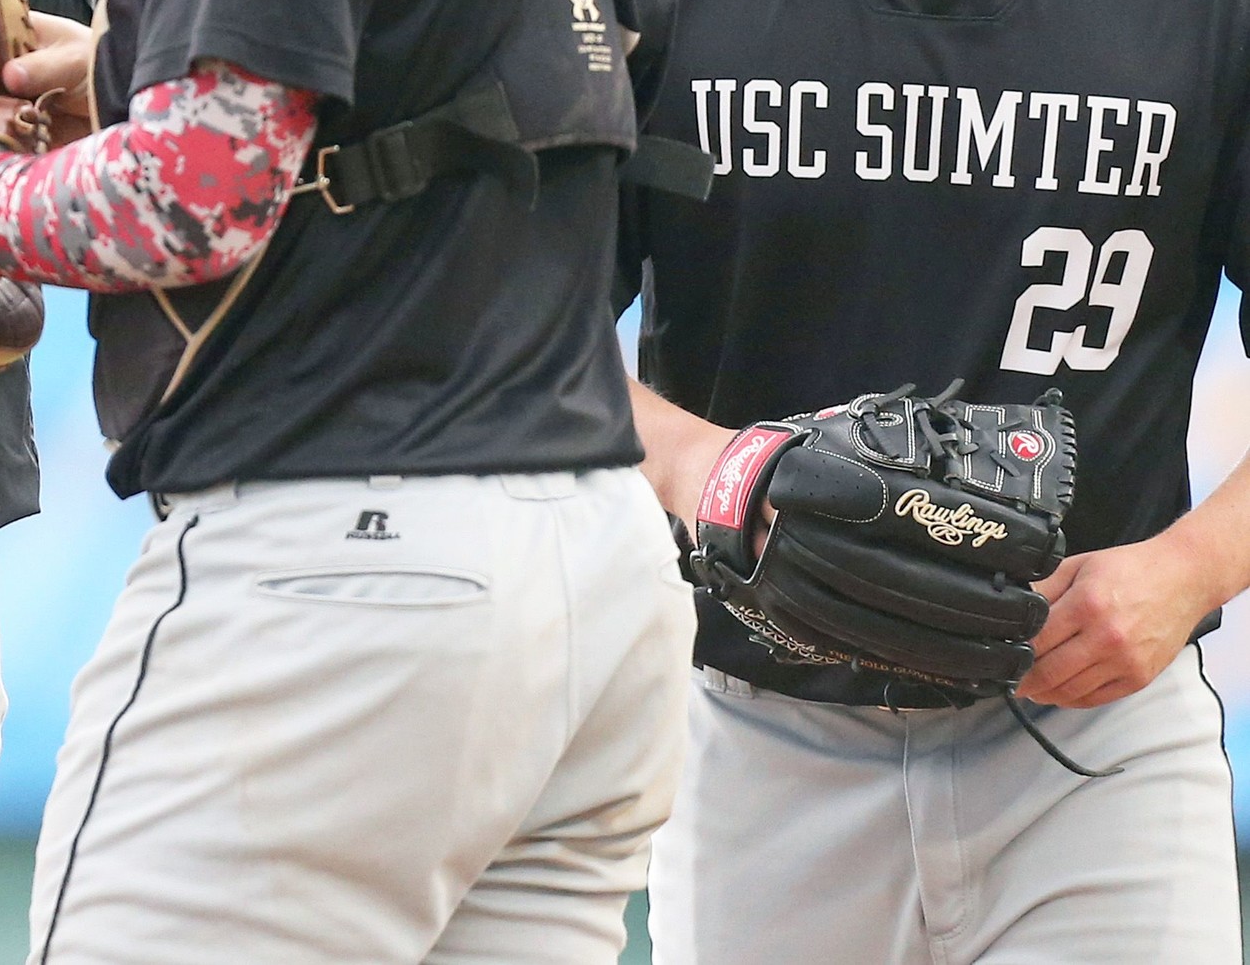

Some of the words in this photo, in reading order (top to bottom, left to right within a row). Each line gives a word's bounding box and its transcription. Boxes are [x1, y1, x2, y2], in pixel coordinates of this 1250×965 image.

[691, 78, 829, 179] USC
[854, 82, 1178, 197] SUMTER
[999, 225, 1155, 376] 29
[718, 436, 765, 514] Rawlings
[894, 489, 1008, 548] Rawlings
